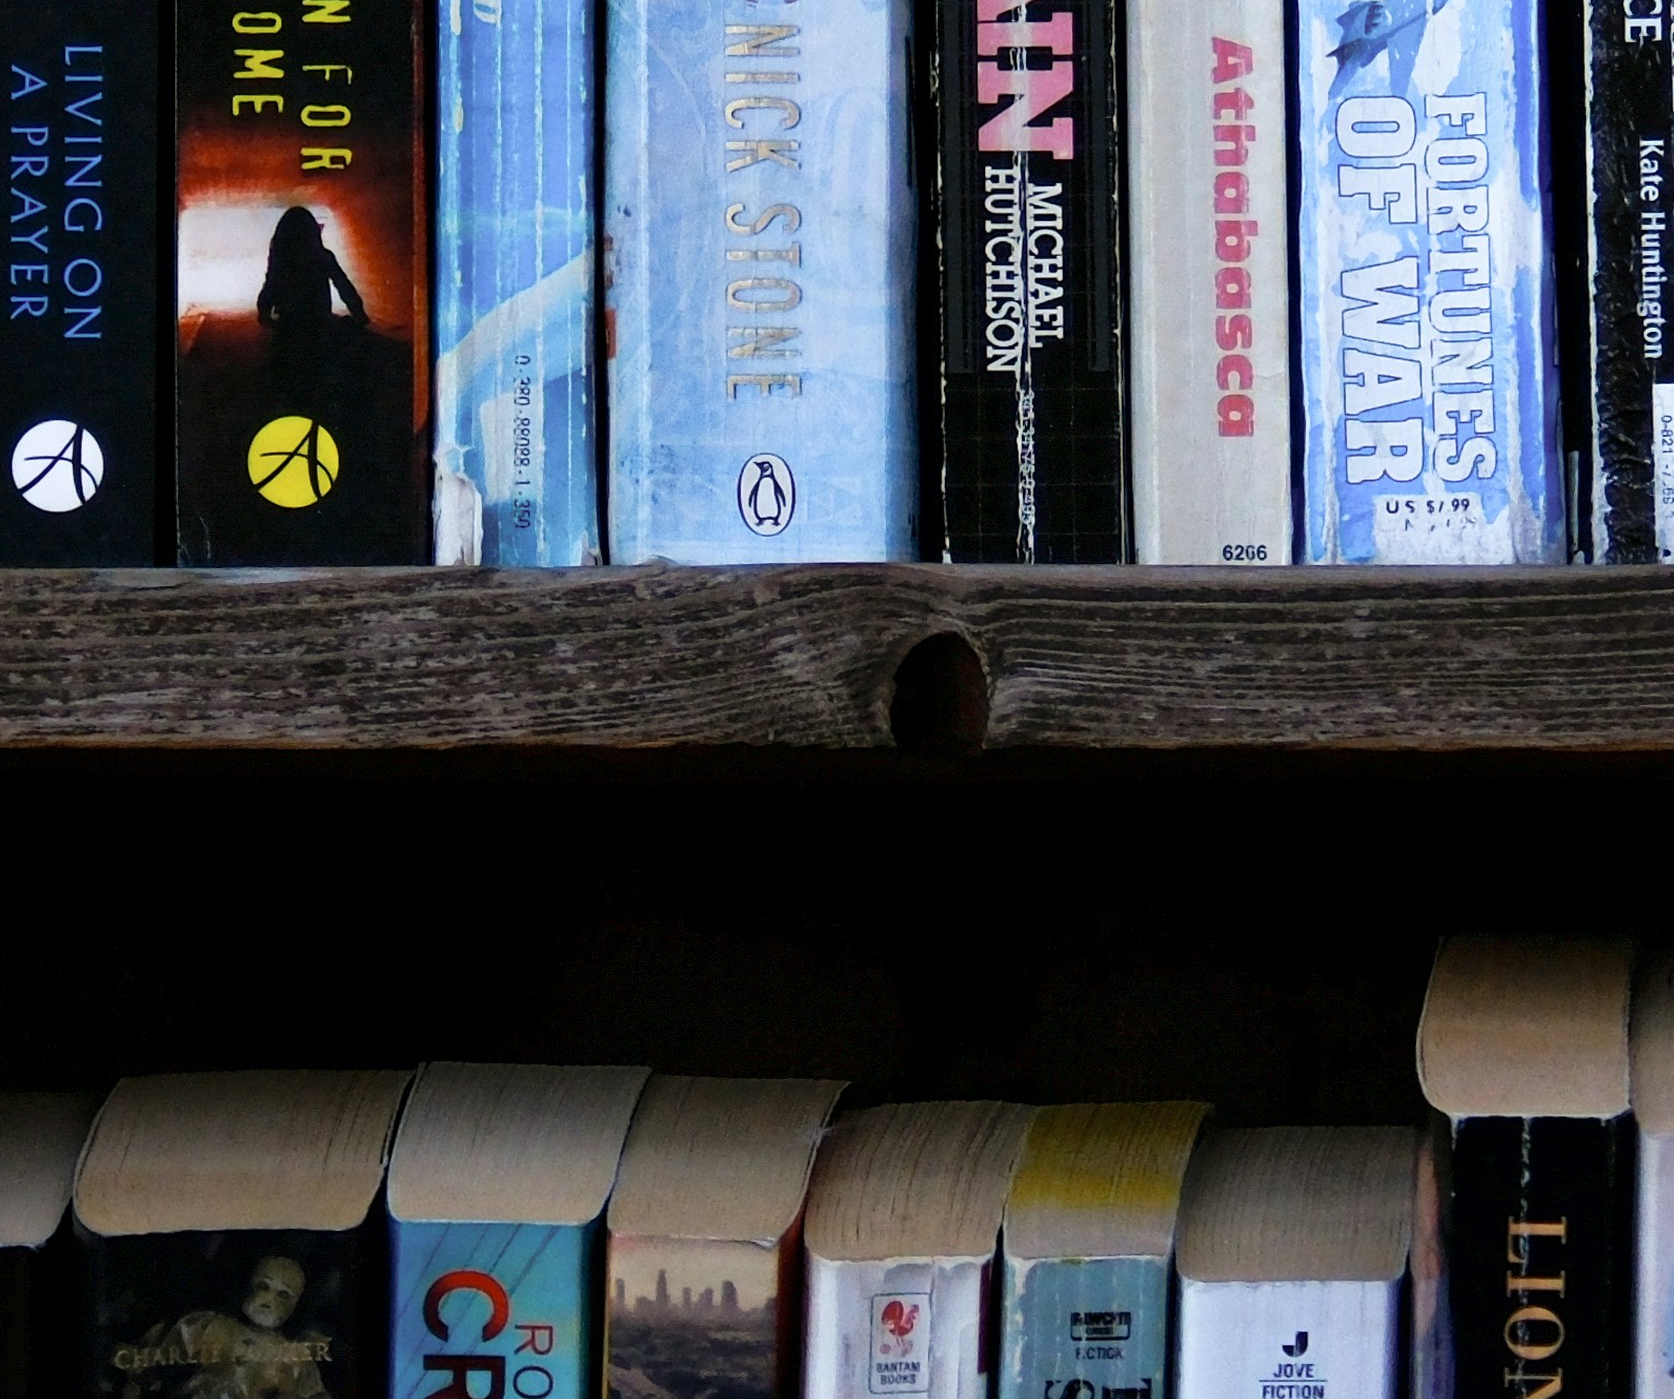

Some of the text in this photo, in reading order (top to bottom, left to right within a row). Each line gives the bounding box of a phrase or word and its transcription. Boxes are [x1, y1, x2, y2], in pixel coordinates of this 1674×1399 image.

[63, 44, 103, 341] LIVING ON
[299, 64, 354, 172] FOR
[1637, 138, 1666, 200] Kate
[723, 23, 803, 402] NICK STONE
[1025, 182, 1065, 351] MICHAEL
[1211, 36, 1258, 438] Athabasca
[1632, 210, 1663, 362] Huntington
[1272, 1362, 1315, 1378] JOVE
